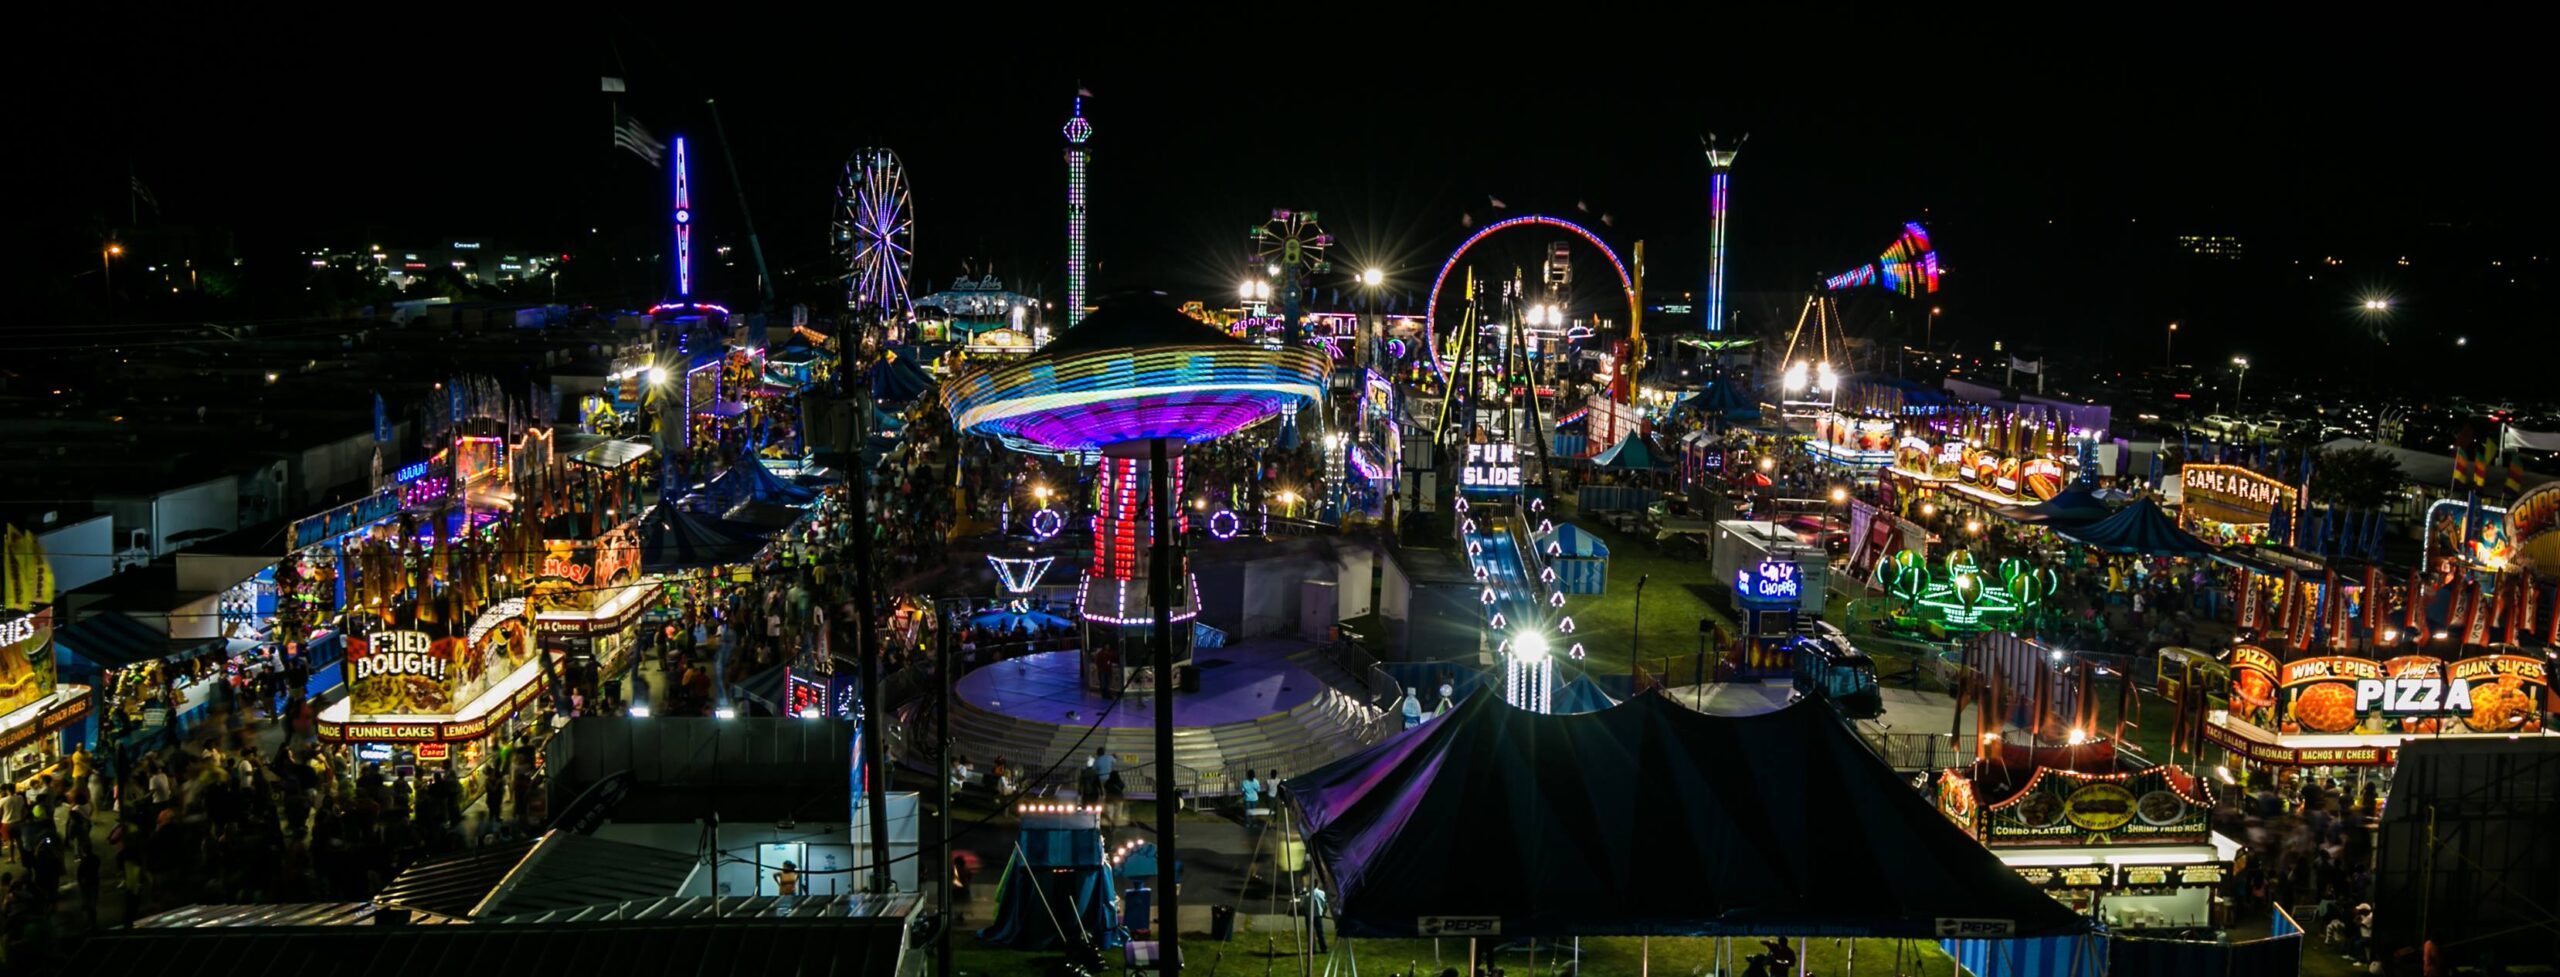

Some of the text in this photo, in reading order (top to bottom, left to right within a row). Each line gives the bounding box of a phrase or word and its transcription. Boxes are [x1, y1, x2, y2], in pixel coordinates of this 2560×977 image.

[1468, 443, 1514, 463] FUN
[1463, 466, 1521, 486] SLIDE
[2024, 464, 2040, 476] HOT
[2187, 469, 2225, 492] GAME
[1759, 580, 1797, 596] CHOPPER
[551, 621, 581, 632] Cheese
[369, 631, 431, 654] FRIED
[357, 652, 447, 681] DOUGH!
[2236, 648, 2278, 677] PIZZA
[2345, 661, 2376, 679] PIES
[2497, 659, 2541, 678] SLICES
[2356, 678, 2473, 711] PIZZA
[42, 700, 87, 728] FRENCH FRIES
[348, 726, 435, 738] FUNNEL CAKES
[443, 720, 486, 737] LEMONADE
[2207, 726, 2248, 751] TACO SALADS
[2251, 743, 2294, 760] LEMONADE
[2302, 750, 2333, 760] NACHOS
[2346, 749, 2376, 760] CHEESE
[1996, 825, 2073, 836] COMBO PLATTER
[2127, 822, 2204, 833] SHRIMP FRIED RICE
[1444, 919, 1492, 931] PEPSI
[1959, 922, 2008, 934] PEPSI
